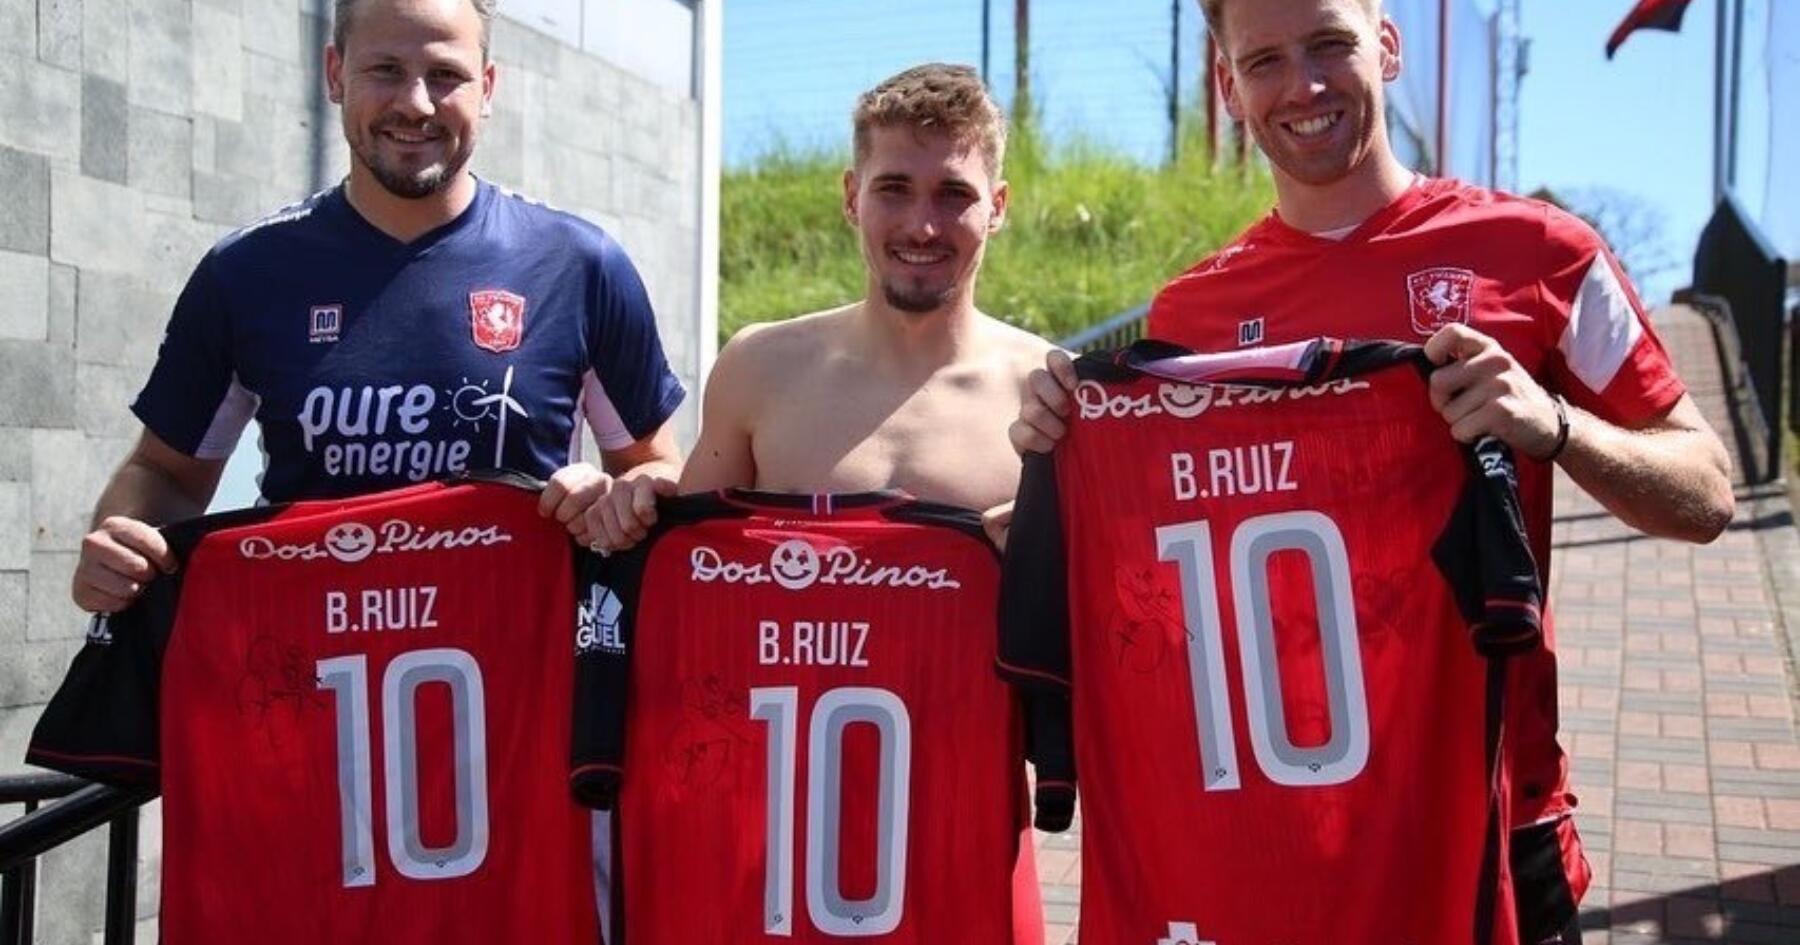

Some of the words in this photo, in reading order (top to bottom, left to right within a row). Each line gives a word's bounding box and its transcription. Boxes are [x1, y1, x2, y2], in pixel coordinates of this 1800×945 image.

[297, 384, 436, 452] pure
[1075, 378, 1162, 419] Dos
[324, 440, 471, 481] energie
[1171, 441, 1298, 501] B.RUIZ
[239, 536, 328, 560] Dos
[376, 519, 512, 553] Pinos
[691, 546, 771, 583] Dos
[819, 546, 961, 589] Pinos
[326, 586, 438, 633] B.RUIZ
[758, 620, 870, 667] B.RUIZ
[1155, 511, 1371, 792] 10
[316, 648, 490, 888] 10
[749, 686, 912, 937] 10
